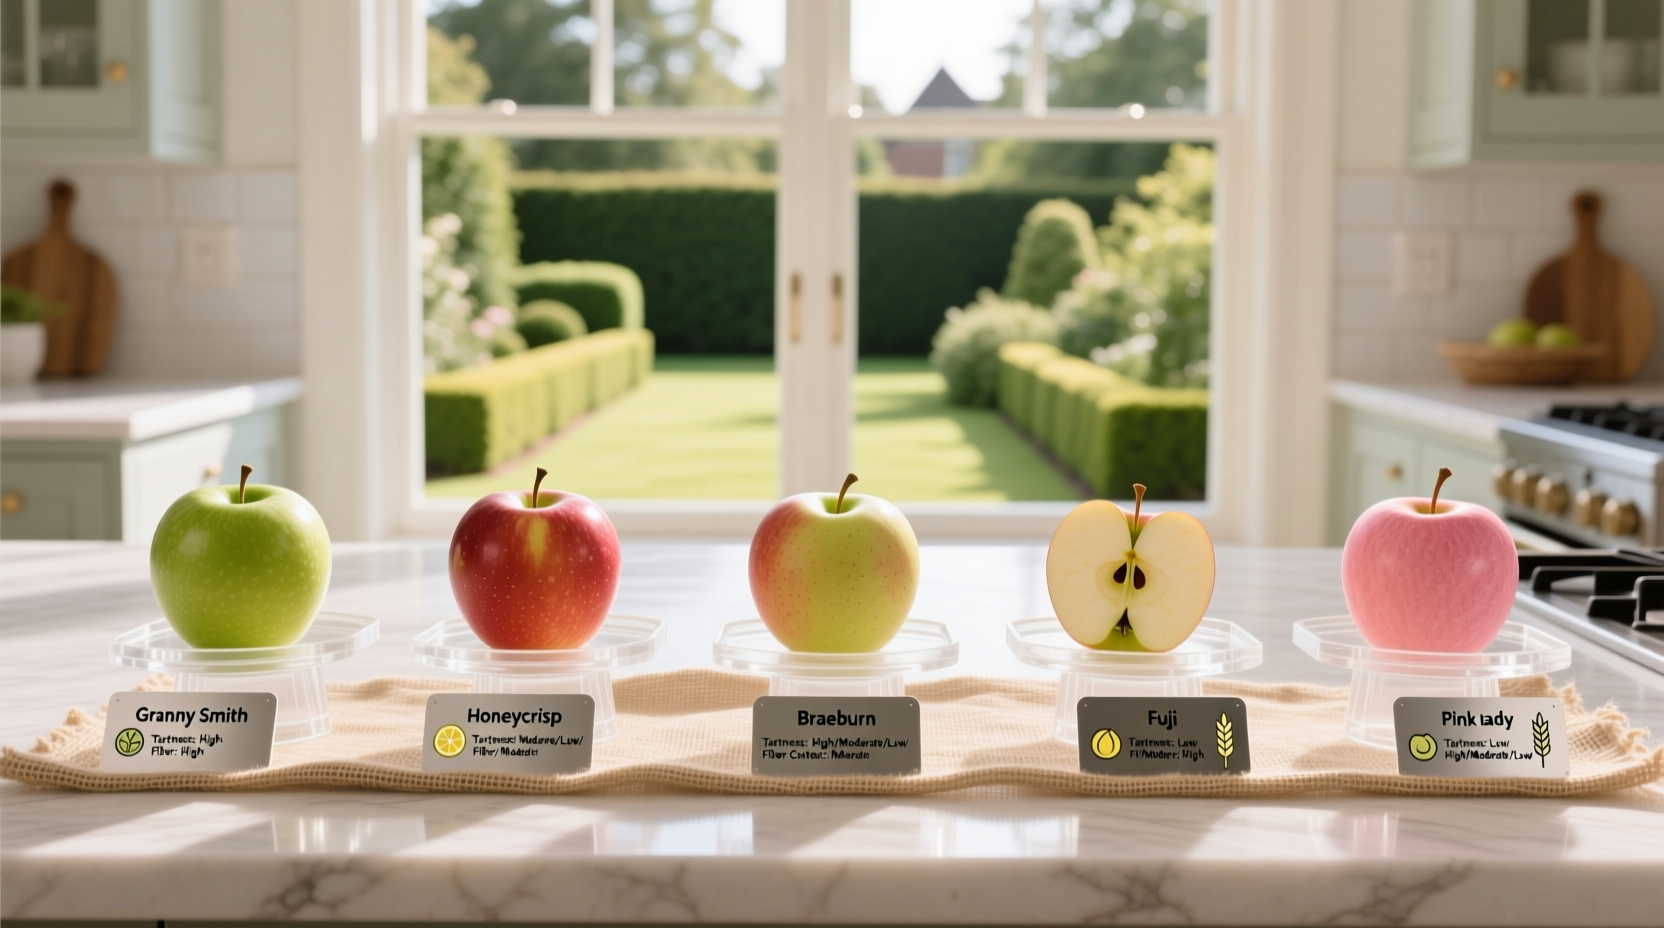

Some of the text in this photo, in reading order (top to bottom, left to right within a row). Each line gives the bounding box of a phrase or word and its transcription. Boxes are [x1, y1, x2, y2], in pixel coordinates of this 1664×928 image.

[135, 706, 249, 728] Granny Smith
[467, 707, 563, 729] Honeycrisp
[797, 709, 876, 726] Braeburn
[1148, 709, 1178, 730] Fuji
[1441, 710, 1477, 726] Pink
